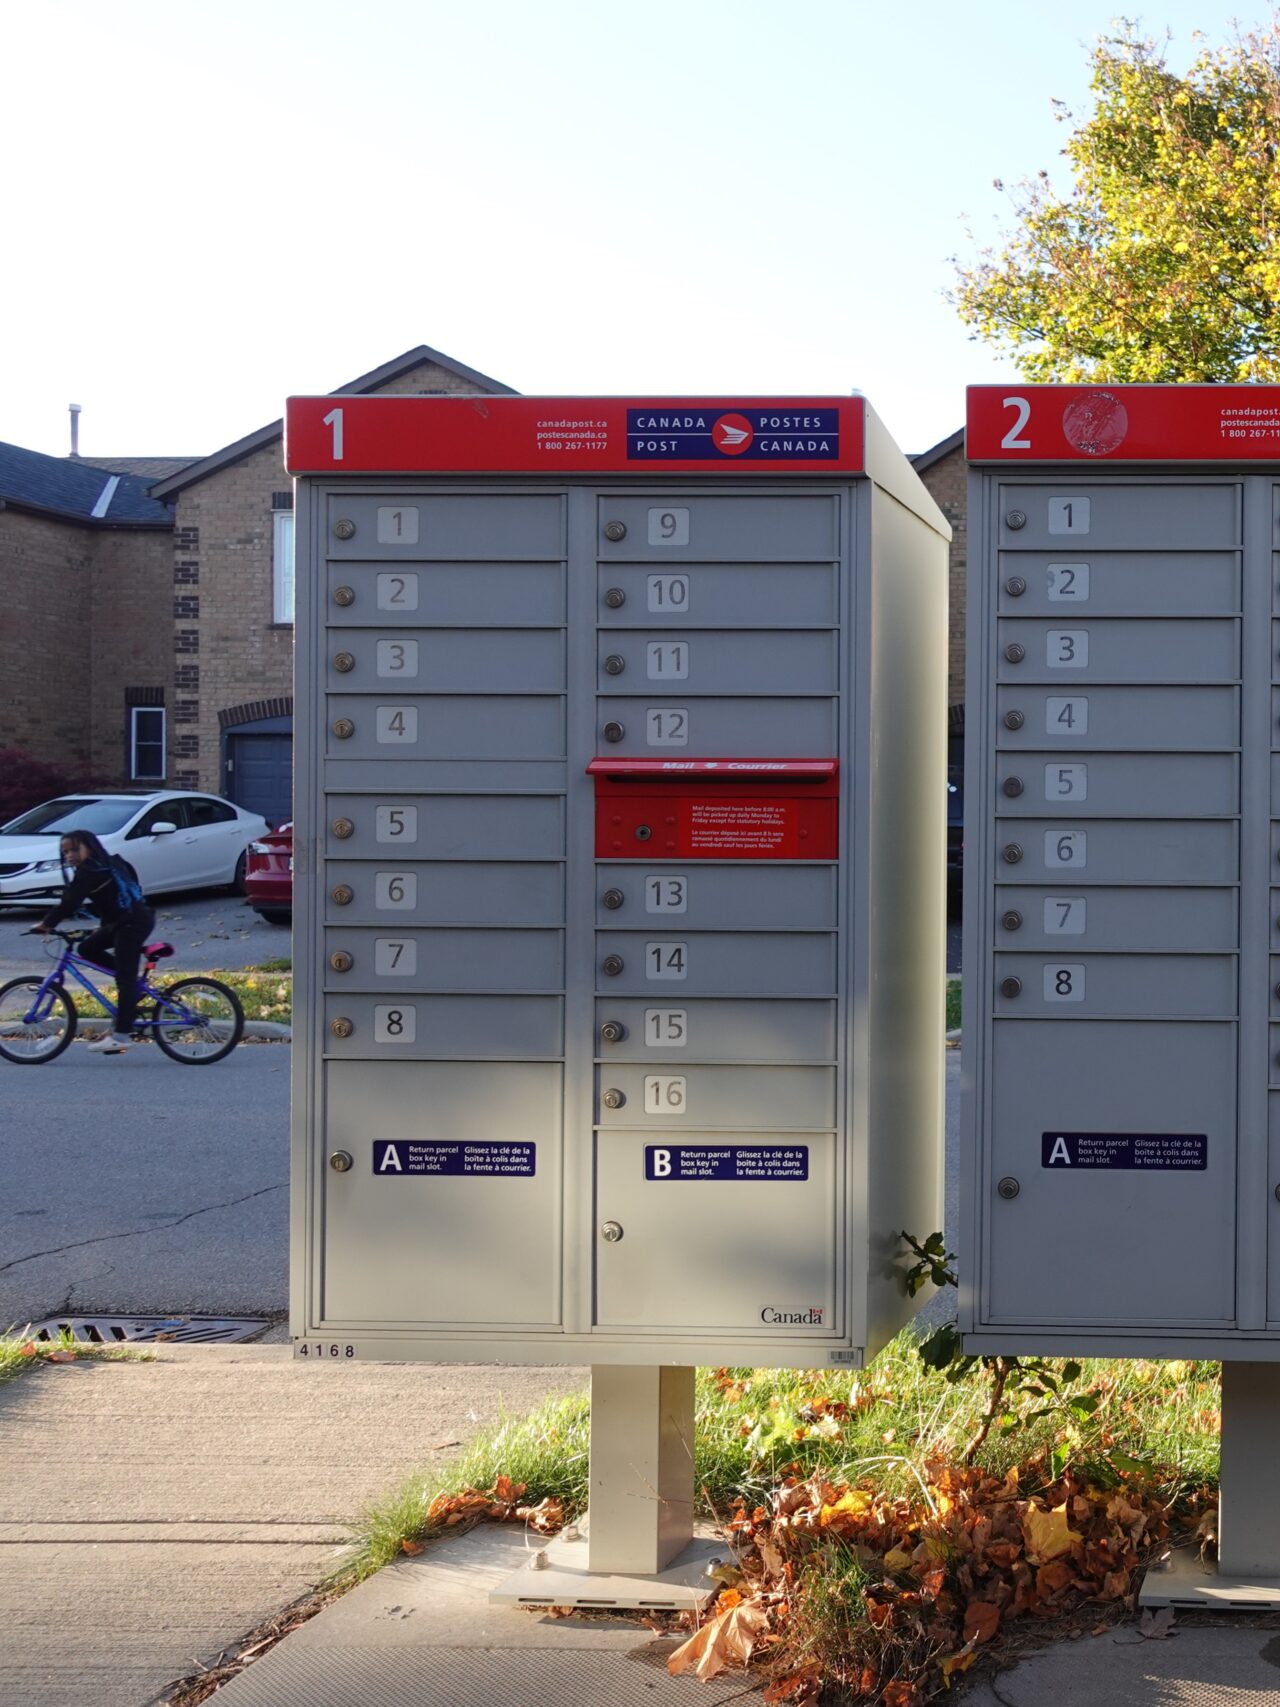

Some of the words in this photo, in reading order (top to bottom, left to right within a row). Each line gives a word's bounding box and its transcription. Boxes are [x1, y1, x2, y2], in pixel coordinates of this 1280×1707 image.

[323, 409, 343, 460] 1
[536, 420, 607, 429] canadapost.ca
[537, 431, 607, 440] postescanada.ca
[637, 418, 706, 428] CANADA
[760, 417, 821, 428] POSTES
[1001, 397, 1031, 449] 2
[1229, 430, 1246, 438] 800
[637, 442, 678, 451] POST
[760, 441, 829, 451] CANADA
[392, 511, 402, 537] 1
[660, 512, 677, 539] 9
[1063, 502, 1073, 528] 1
[390, 577, 405, 603] 2
[652, 579, 686, 605] 10
[1059, 569, 1076, 595] 2
[389, 644, 405, 671] 3
[652, 646, 681, 673] 11
[1058, 635, 1075, 662] 3
[388, 711, 406, 737] 4
[652, 713, 684, 739] 12
[1057, 703, 1076, 729] 4
[727, 762, 788, 770] Courrier
[1058, 769, 1074, 795] 5
[389, 810, 405, 836] 5
[1056, 835, 1074, 862] 6
[388, 876, 405, 903] 6
[651, 880, 683, 907] 13
[1055, 902, 1072, 928] 7
[388, 943, 404, 969] 7
[651, 947, 685, 973] 14
[1055, 969, 1073, 996] 8
[386, 1010, 404, 1036] 8
[650, 1013, 683, 1040] 15
[650, 1080, 683, 1107] 16
[436, 1147, 458, 1155] parcel
[1049, 1137, 1071, 1163] A
[1094, 1148, 1107, 1156] key
[1106, 1140, 1128, 1148] parcel
[380, 1145, 402, 1170] A
[425, 1155, 438, 1163] key
[654, 1150, 671, 1177] B
[762, 1307, 823, 1324] Canada
